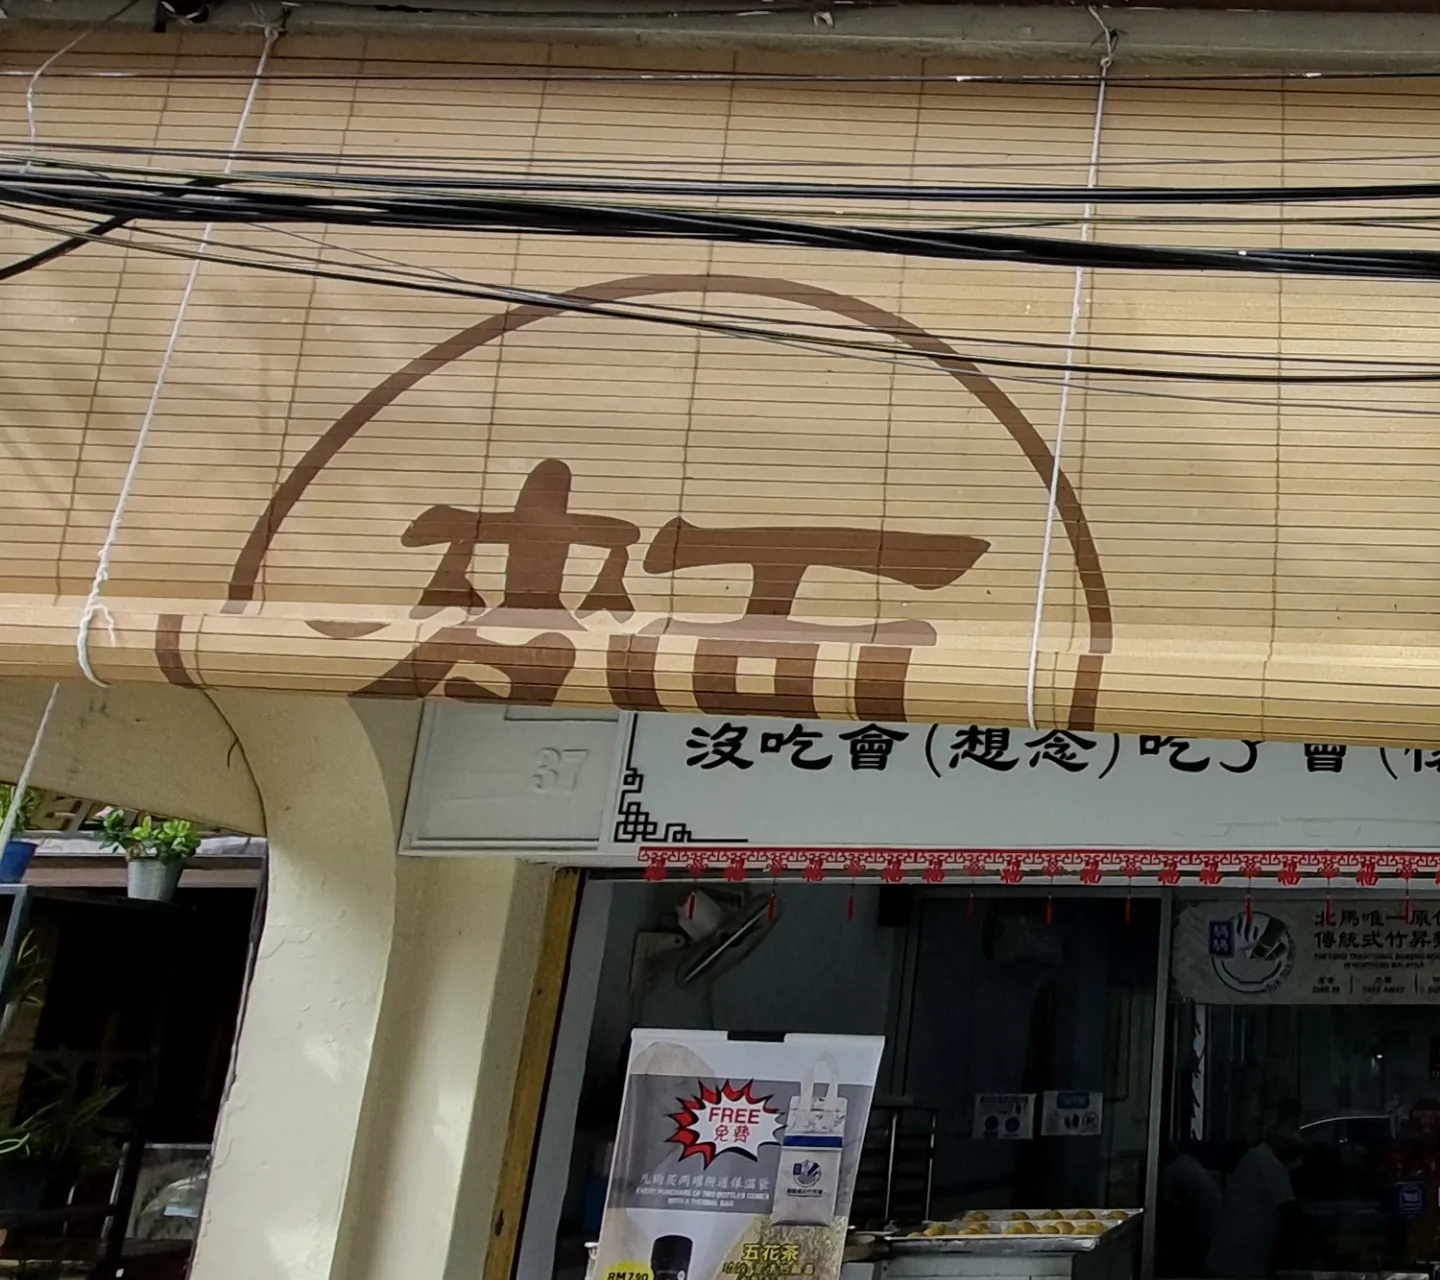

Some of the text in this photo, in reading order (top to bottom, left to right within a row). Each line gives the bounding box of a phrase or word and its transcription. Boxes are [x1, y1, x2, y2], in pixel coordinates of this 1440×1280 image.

[708, 1106, 762, 1125] FREE
[713, 1124, 751, 1143] 免费
[742, 1242, 800, 1262] 五花茶
